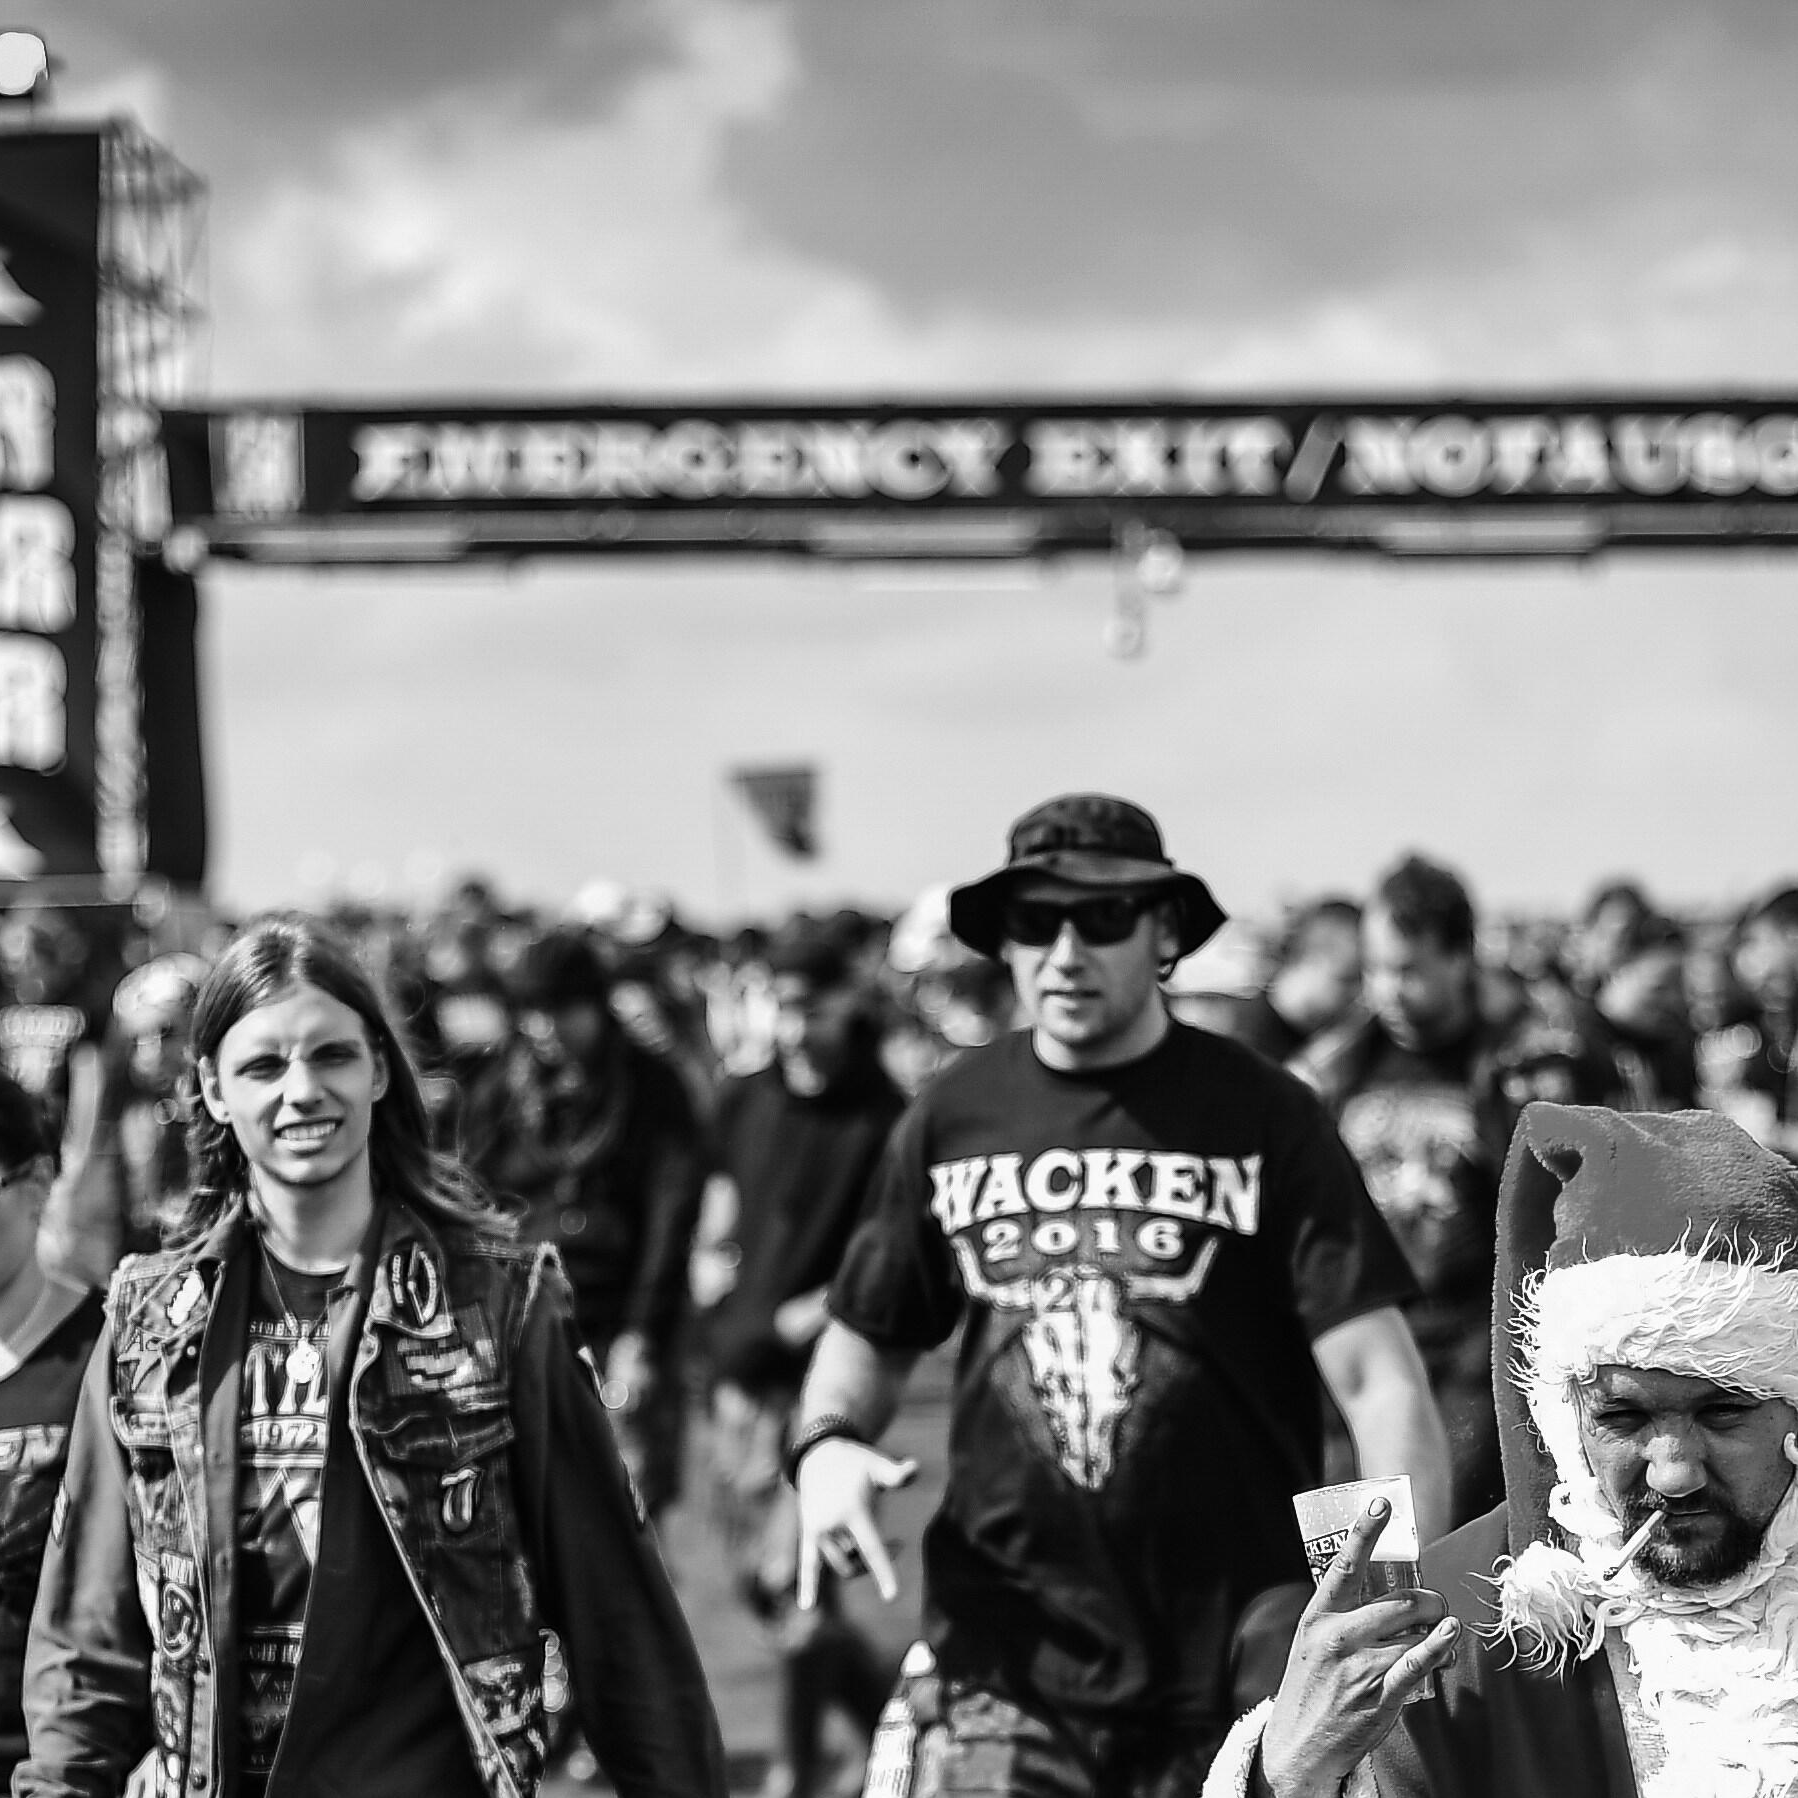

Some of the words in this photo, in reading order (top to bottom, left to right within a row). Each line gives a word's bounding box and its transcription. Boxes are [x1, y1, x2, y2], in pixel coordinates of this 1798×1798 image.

[351, 419, 1012, 502] EMERGENCY
[928, 1147, 1264, 1236] WACKEN
[980, 1217, 1187, 1264] 2016
[257, 1422, 319, 1450] 1972
[1304, 1529, 1349, 1557] KEN
